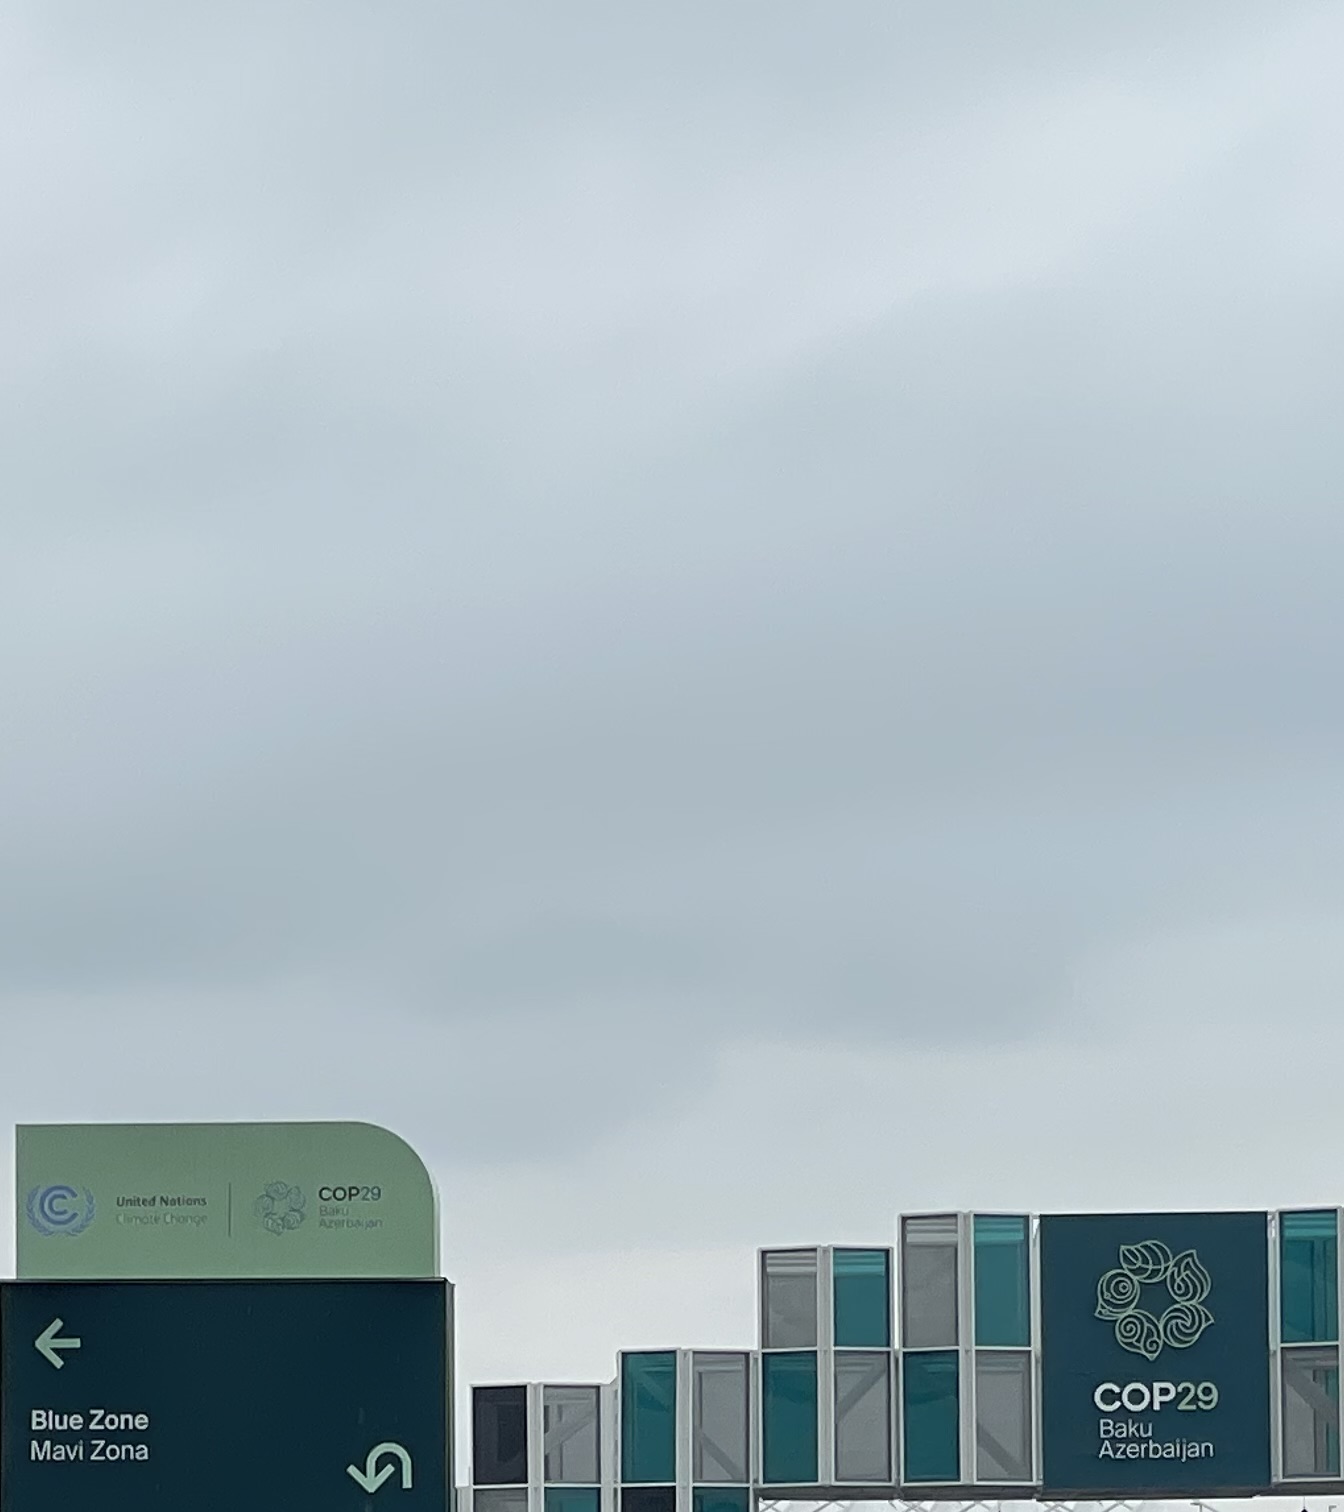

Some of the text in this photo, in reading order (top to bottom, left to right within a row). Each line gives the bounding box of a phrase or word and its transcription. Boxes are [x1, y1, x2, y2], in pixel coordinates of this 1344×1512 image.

[116, 1196, 207, 1207] United Nations
[318, 1186, 382, 1201] COP29
[319, 1206, 349, 1217] Baku
[1093, 1381, 1219, 1412] COP29
[30, 1409, 150, 1431] Blue Zone
[1099, 1419, 1153, 1439] Baku
[30, 1440, 150, 1462] Mavi Zona
[1098, 1439, 1215, 1462] Azerbaijan
